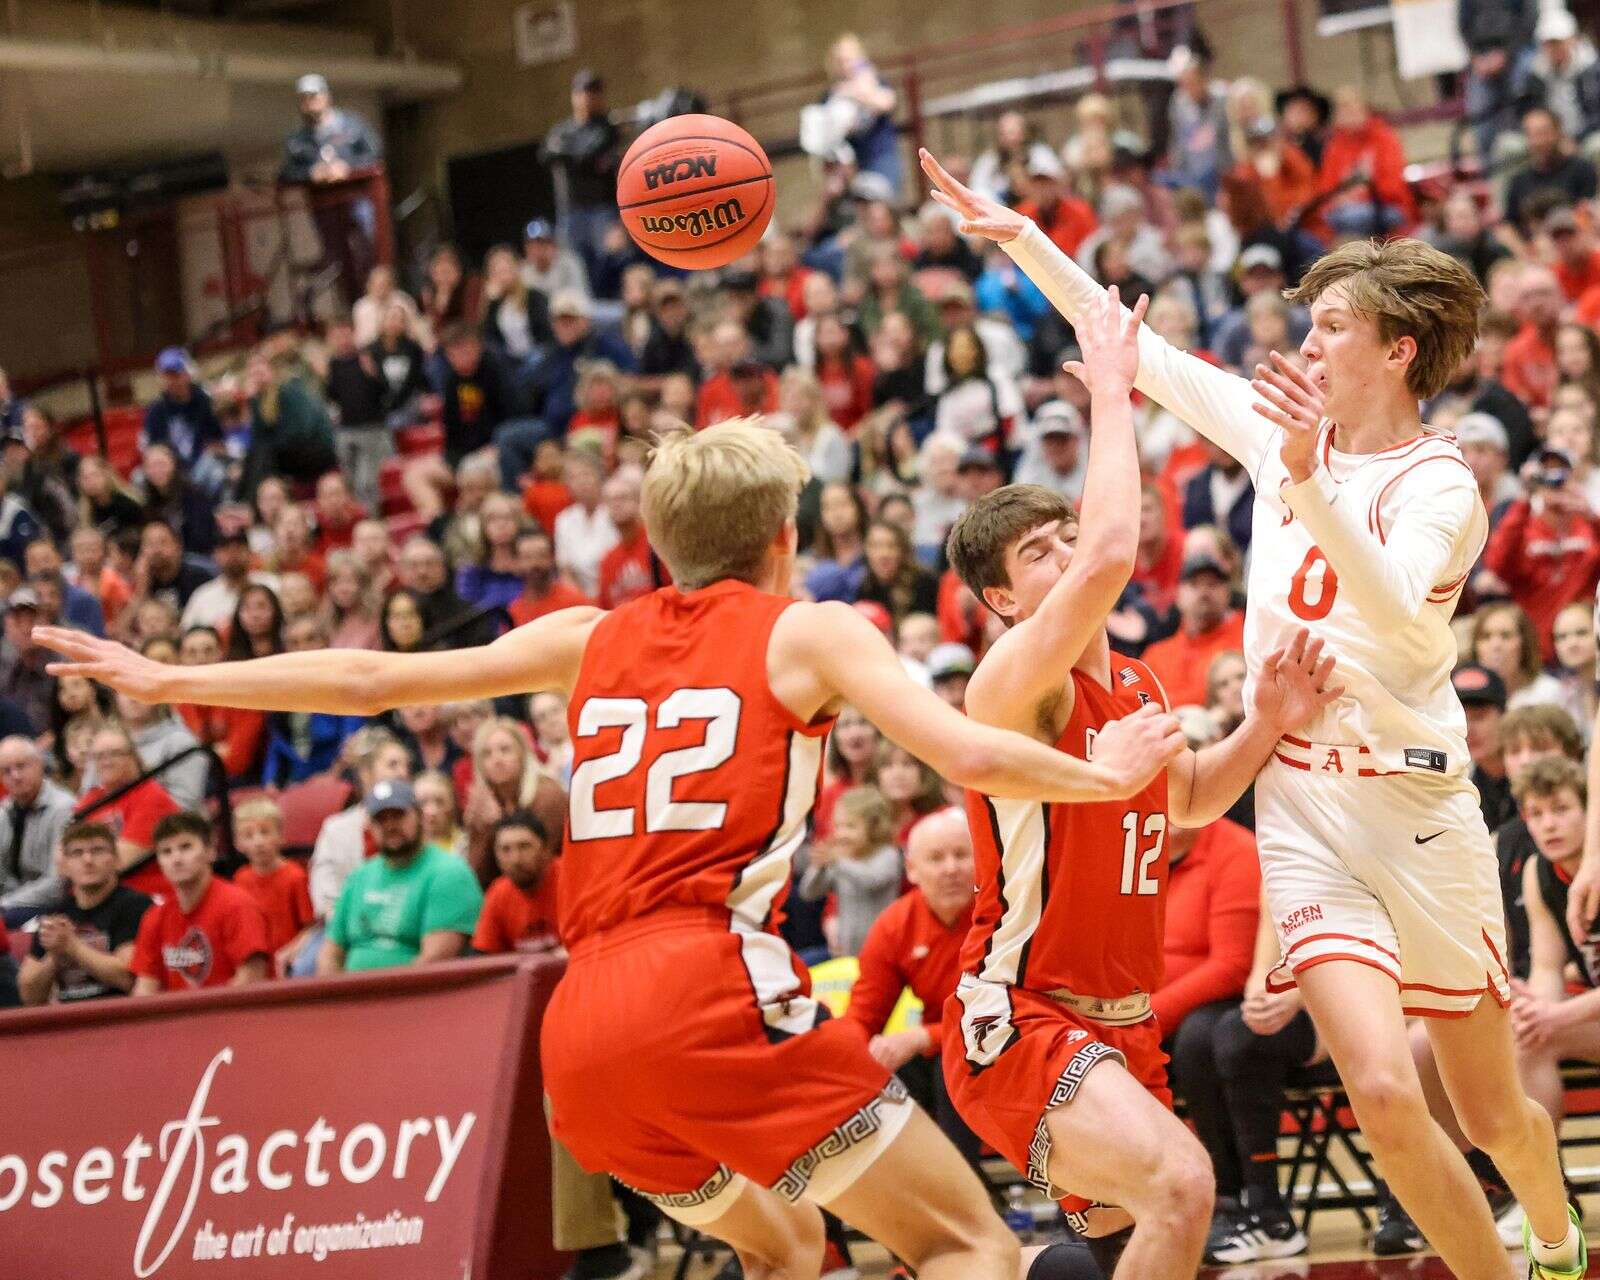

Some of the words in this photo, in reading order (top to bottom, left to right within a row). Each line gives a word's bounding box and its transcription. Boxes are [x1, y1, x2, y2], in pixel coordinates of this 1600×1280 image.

[643, 155, 717, 191] NCAA
[640, 197, 746, 237] Wilson
[1287, 544, 1338, 621] 0
[568, 686, 743, 843] 22
[1321, 748, 1344, 774] A
[1119, 810, 1167, 896] 12
[1280, 903, 1322, 930] ASPEN
[192, 1219, 229, 1262] the
[230, 1222, 266, 1259] art
[266, 1212, 296, 1257] of
[293, 1209, 425, 1263] organization
